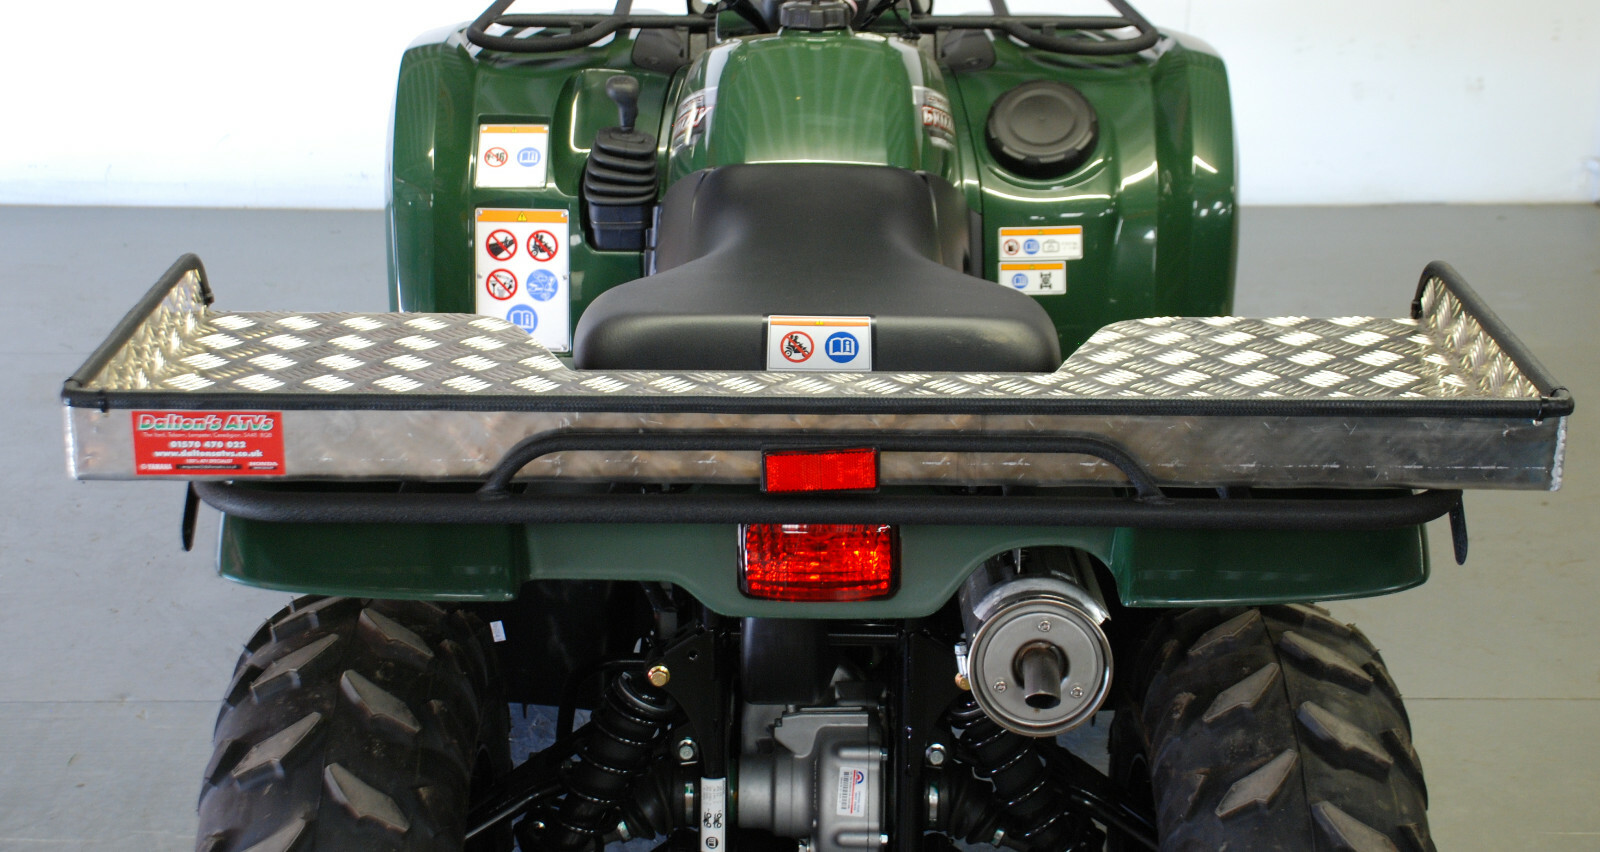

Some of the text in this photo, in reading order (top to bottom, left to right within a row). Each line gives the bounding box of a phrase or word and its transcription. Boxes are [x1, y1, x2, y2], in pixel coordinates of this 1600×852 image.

[138, 413, 274, 431] Dalton's ATVs
[169, 440, 247, 448] 01570 470 022
[153, 449, 264, 457] www.daltonsatvs.co.uk
